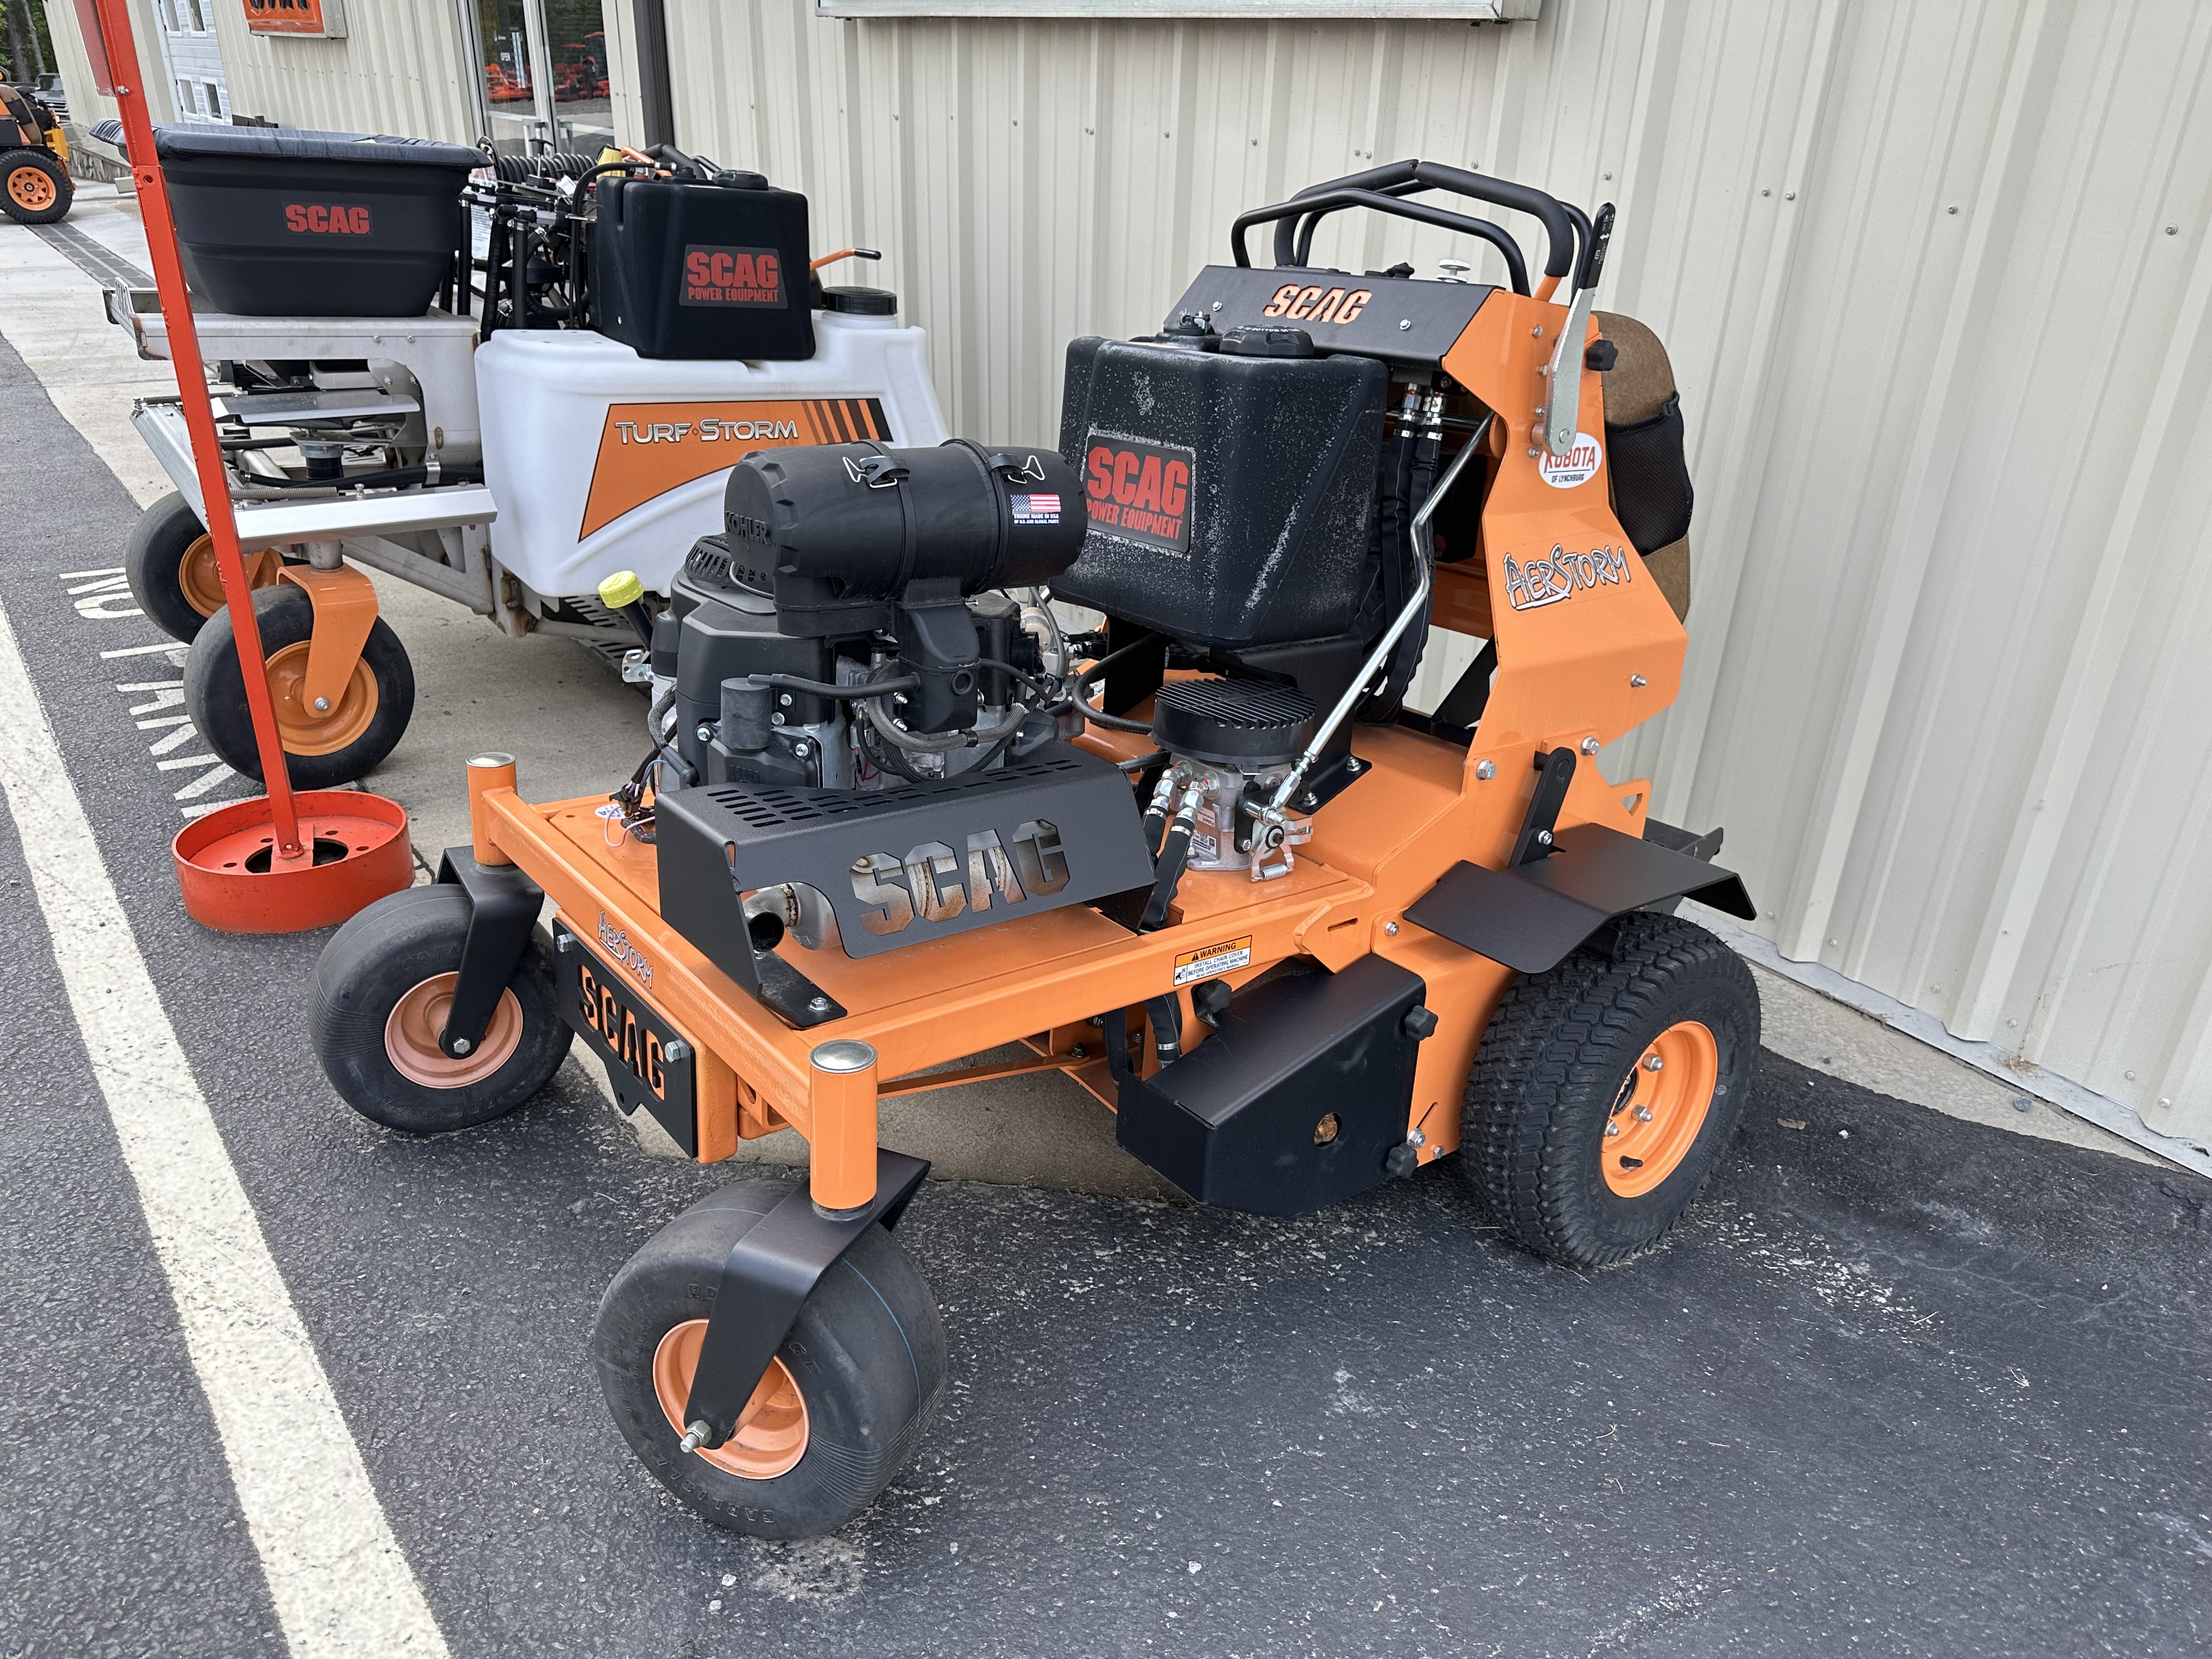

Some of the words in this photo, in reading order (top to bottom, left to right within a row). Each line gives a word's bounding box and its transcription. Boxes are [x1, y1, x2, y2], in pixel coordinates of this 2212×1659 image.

[285, 204, 370, 234] SCAG
[687, 251, 778, 289] SCAG
[688, 286, 722, 301] POWER
[725, 288, 778, 302] EQUIPMENT
[1262, 284, 1372, 324] SCAG
[614, 422, 692, 444] TURF
[700, 419, 799, 441] STORM
[1543, 447, 1595, 473] KUBOTA
[1087, 447, 1189, 516] SCAG
[1559, 474, 1584, 482] LYNCHBURG
[725, 511, 769, 545] KOHLER
[1087, 498, 1120, 525] POWER
[1120, 507, 1182, 540] EQUIPMENT
[849, 818, 1070, 935] SCAG
[1188, 967, 1204, 976] BEFORE
[1205, 961, 1229, 971] OPERATING
[1229, 955, 1248, 964] MACHINE
[1194, 958, 1212, 968] INSTALL
[1200, 943, 1236, 958] WARNING
[578, 964, 665, 1102] SCAG
[651, 1452, 776, 1524] CARLISLE
